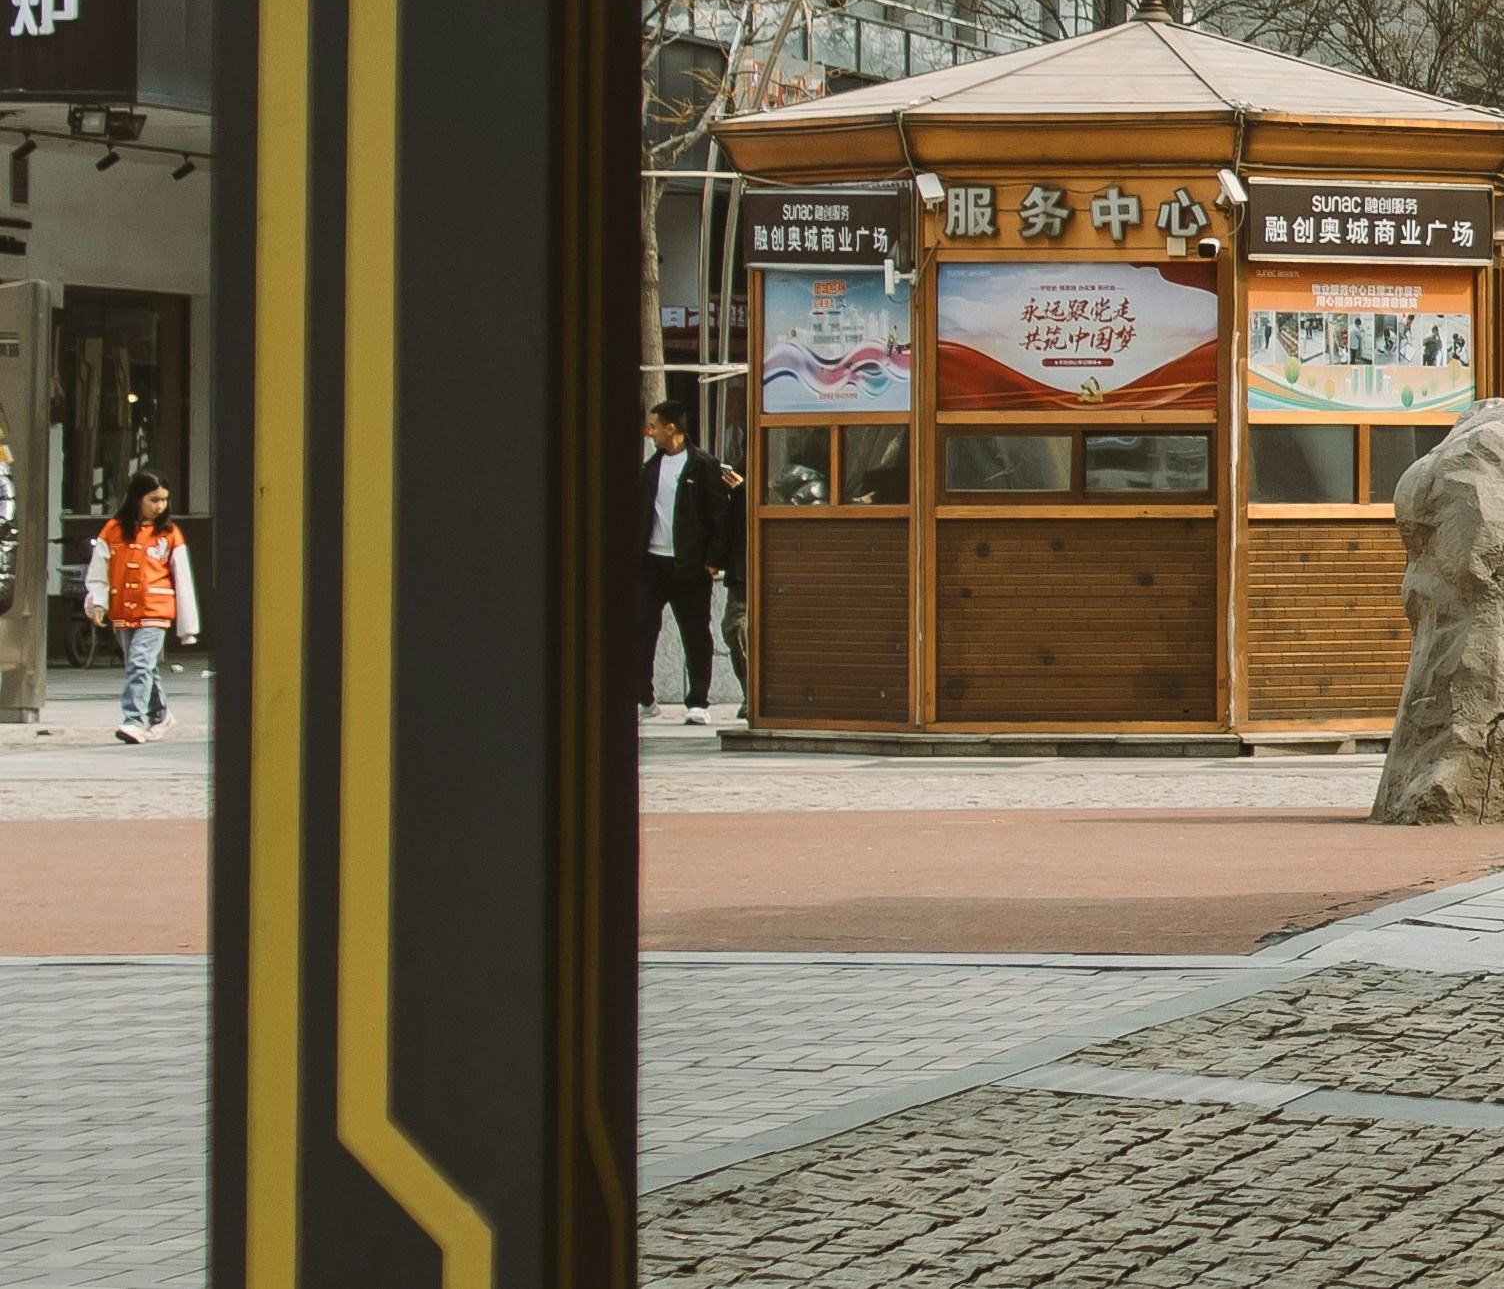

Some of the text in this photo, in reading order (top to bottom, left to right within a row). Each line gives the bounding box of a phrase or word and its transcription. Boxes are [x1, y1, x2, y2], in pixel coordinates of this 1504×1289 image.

[945, 186, 1211, 241] 服务中心
[1364, 197, 1418, 214] 融创服务
[754, 226, 888, 252] 融创奥城商业广场
[1265, 215, 1474, 247] 融创奥城商业广场
[1019, 297, 1137, 323] 永远跟党走
[1018, 325, 1138, 353] 共筑中国梦
